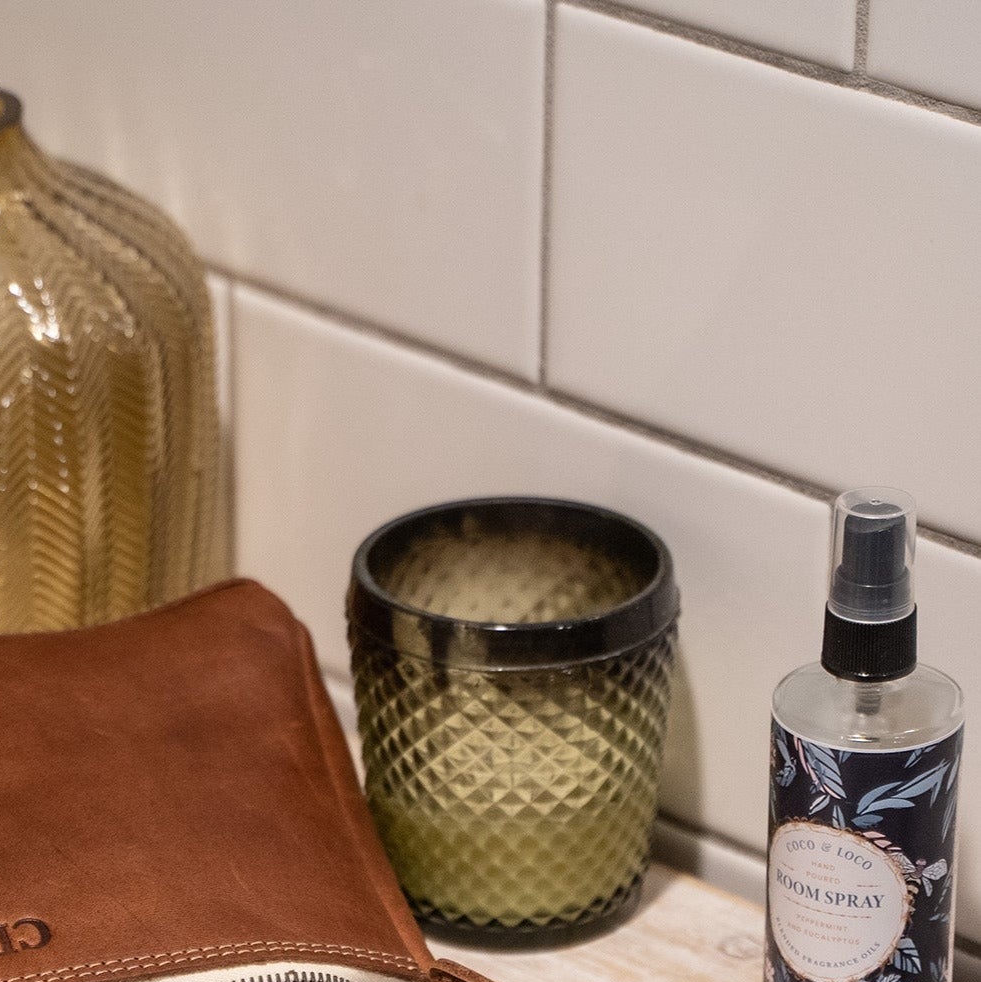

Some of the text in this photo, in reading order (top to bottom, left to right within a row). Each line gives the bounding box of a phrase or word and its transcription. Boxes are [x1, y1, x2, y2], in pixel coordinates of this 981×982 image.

[786, 839, 873, 871] COCO & LOCO
[776, 869, 885, 909] ROOM SPRAY
[802, 954, 859, 968] FRAGRANCE
[861, 942, 881, 960] OILS
